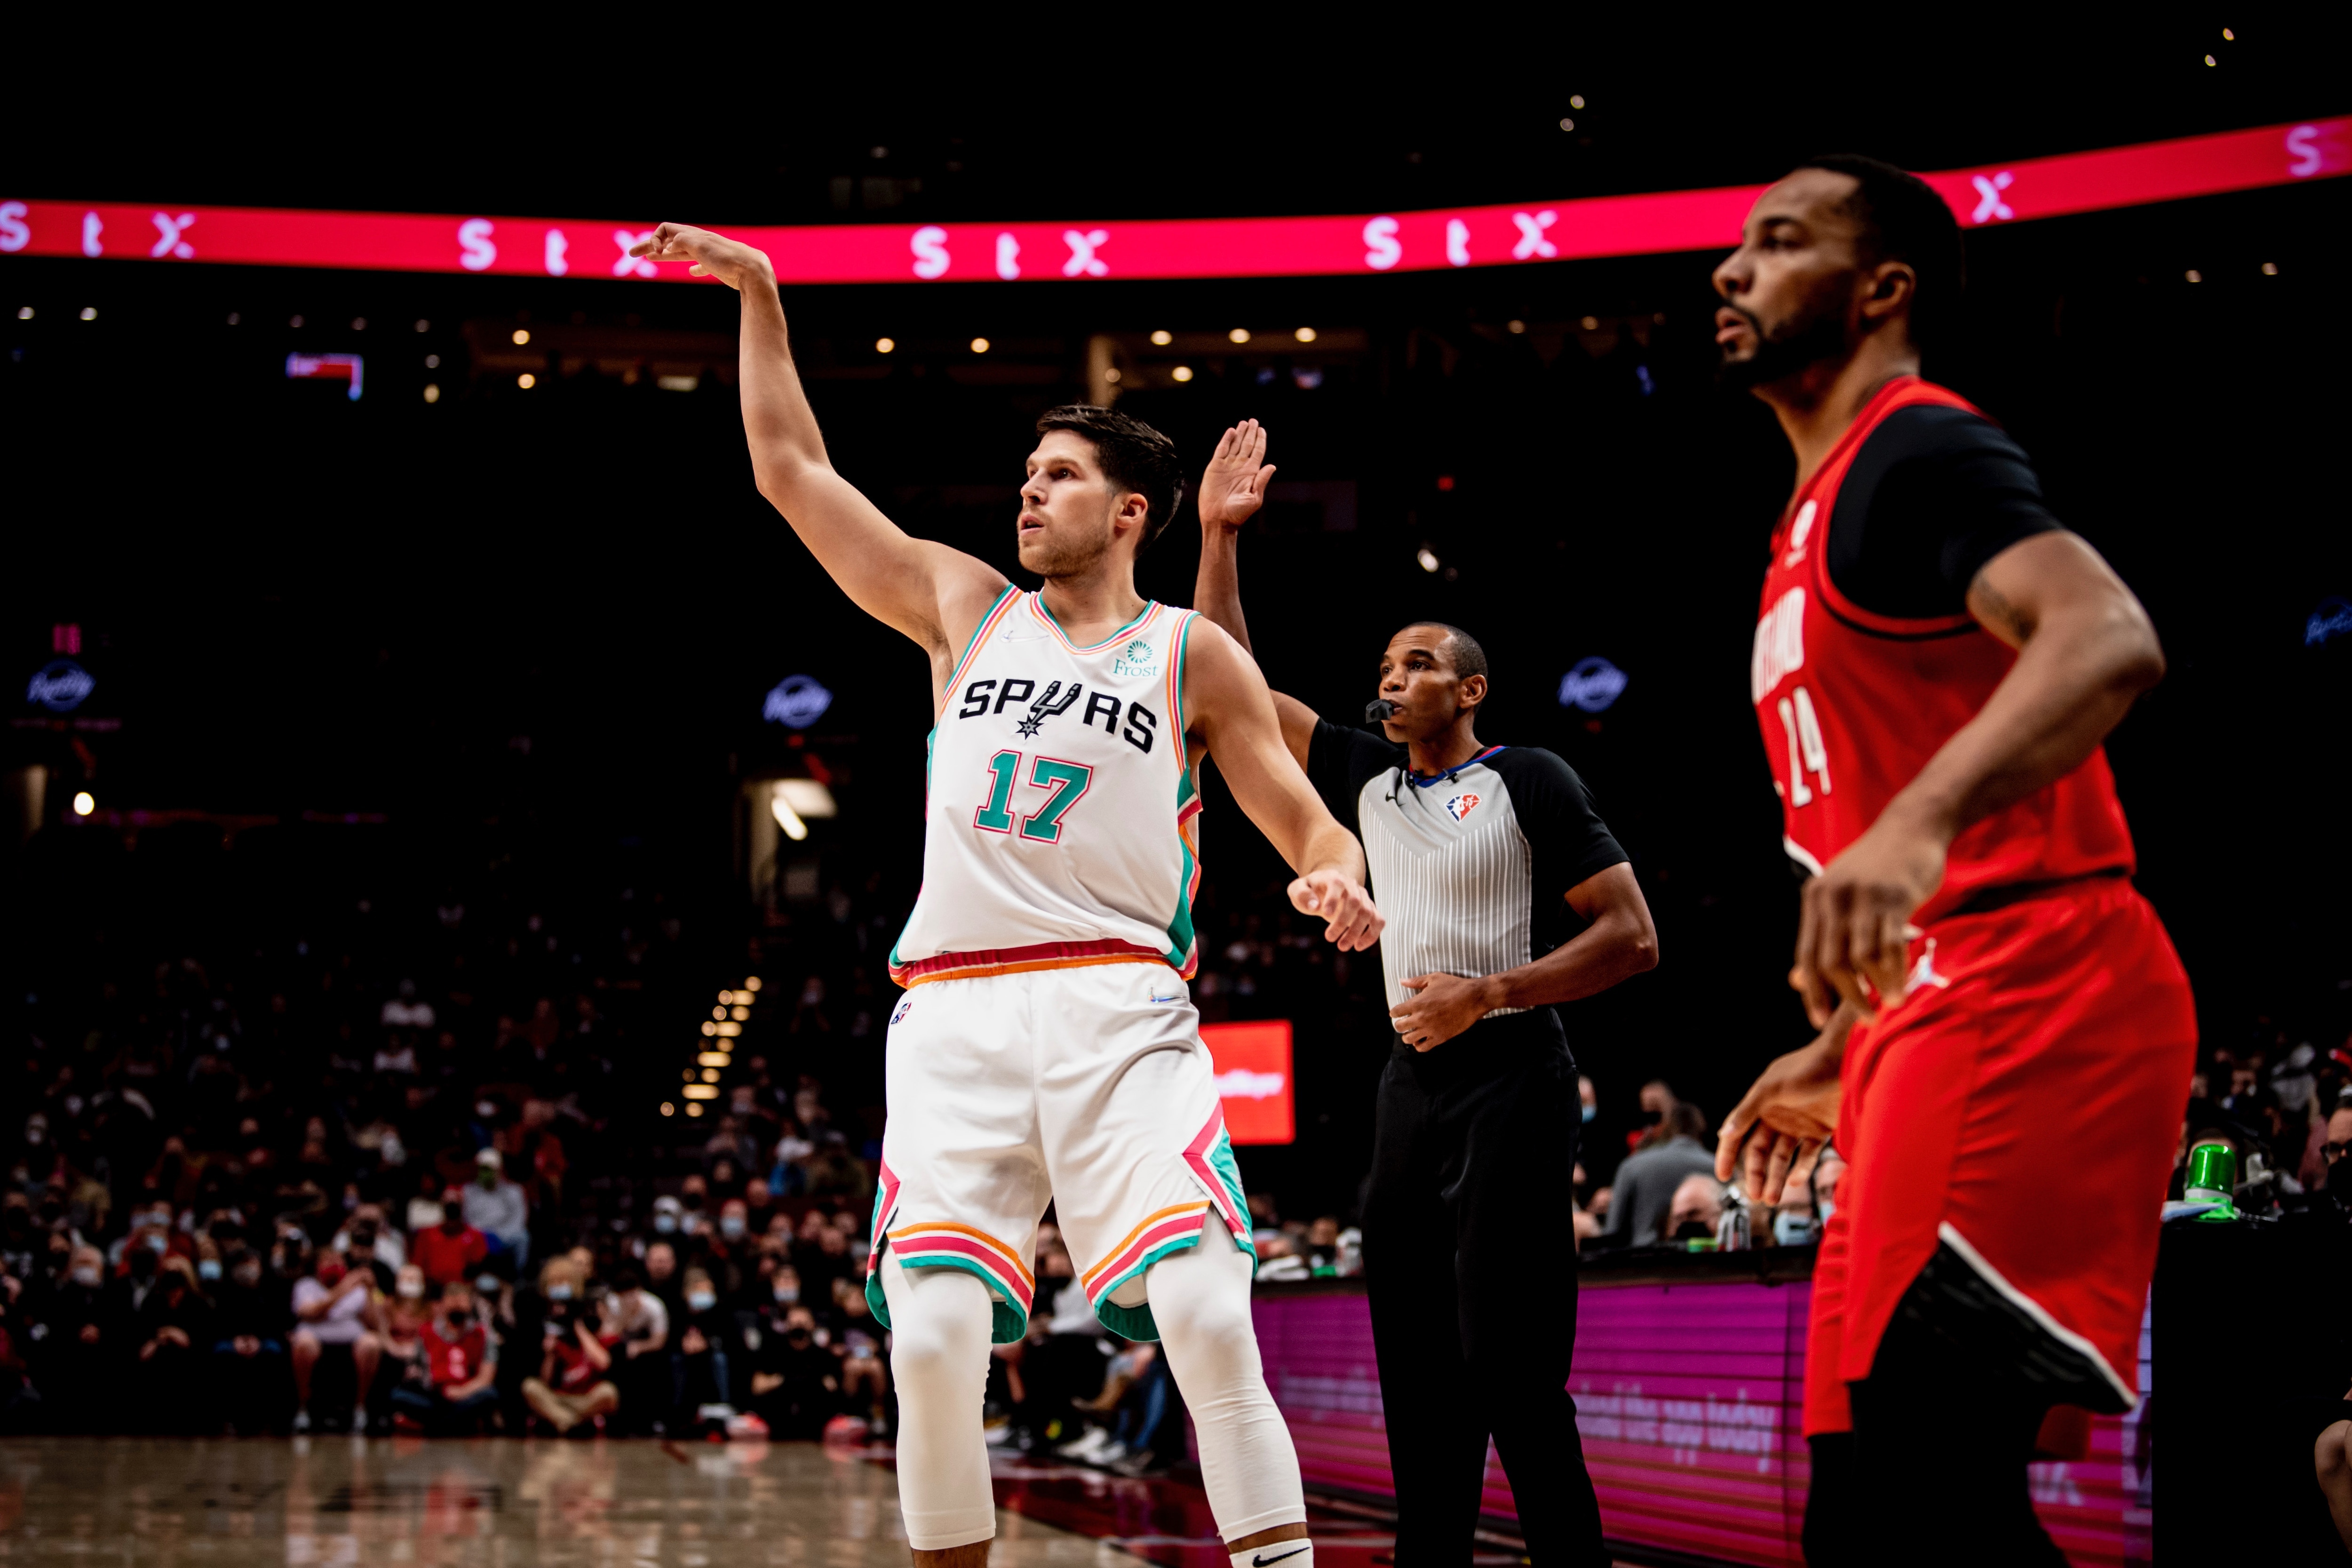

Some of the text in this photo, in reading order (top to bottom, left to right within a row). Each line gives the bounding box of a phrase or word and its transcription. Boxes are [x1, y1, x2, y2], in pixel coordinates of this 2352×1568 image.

[1112, 659, 1158, 677] Frost
[959, 678, 1157, 754] SPURS
[974, 749, 1094, 844] 17
[1465, 796, 1473, 806] 75
